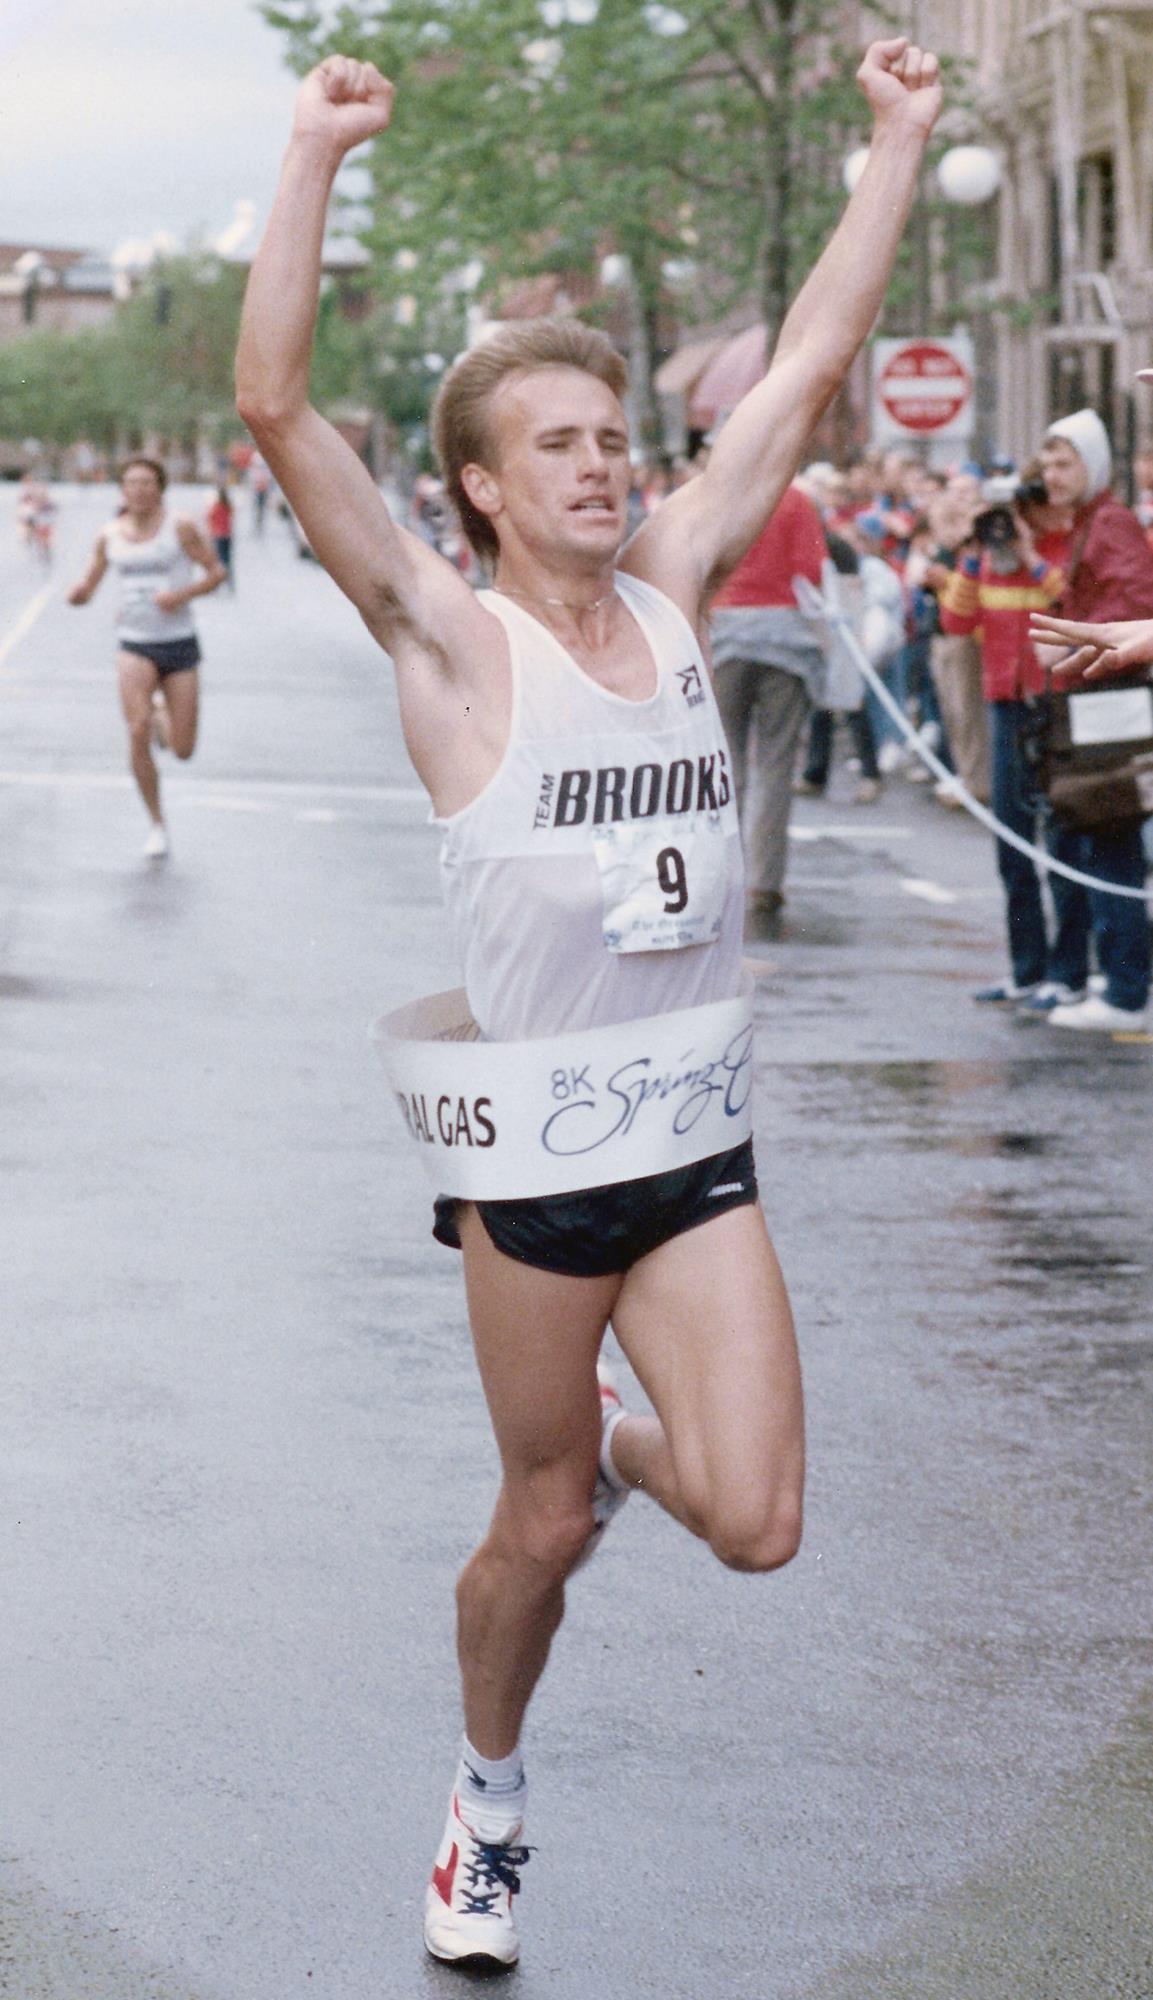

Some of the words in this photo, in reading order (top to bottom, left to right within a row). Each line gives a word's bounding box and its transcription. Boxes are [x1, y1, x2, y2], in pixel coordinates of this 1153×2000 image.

[533, 773, 555, 830] TEAM
[554, 749, 730, 828] BROOKS
[656, 846, 688, 914] 9
[551, 1064, 595, 1100] 8K
[437, 1095, 496, 1148] GAS
